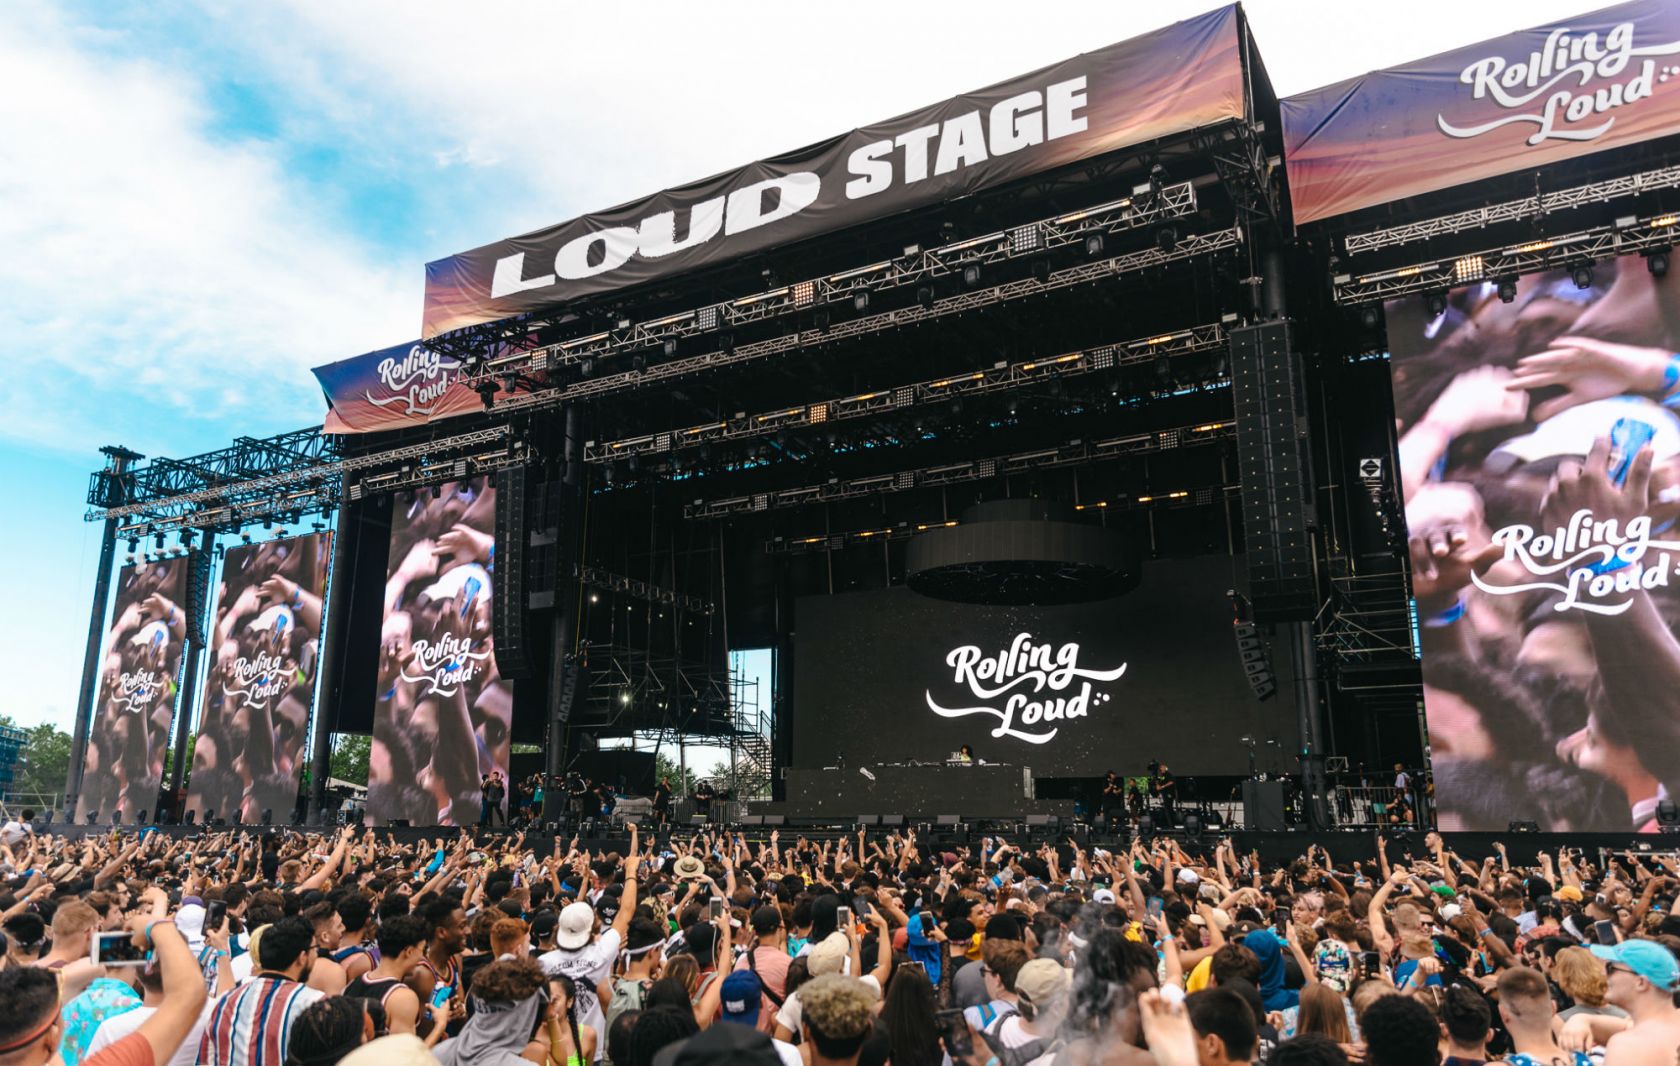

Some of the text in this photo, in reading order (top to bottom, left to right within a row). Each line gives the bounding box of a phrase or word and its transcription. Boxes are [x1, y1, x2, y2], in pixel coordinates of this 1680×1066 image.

[1460, 22, 1680, 107] Rolling
[1437, 59, 1656, 145] Loud
[491, 74, 1088, 299] LOUD STAGE
[366, 371, 447, 415] Loud
[377, 344, 461, 392] Rolling
[1491, 508, 1680, 576] Rolling
[1470, 552, 1671, 616] Loud
[233, 650, 298, 686] Rolling
[400, 660, 474, 698] Loud
[411, 631, 491, 672] Rolling
[946, 632, 1127, 699] Rolling
[120, 667, 164, 695] Rolling
[222, 675, 282, 710] Loud
[926, 681, 1092, 745] Loud
